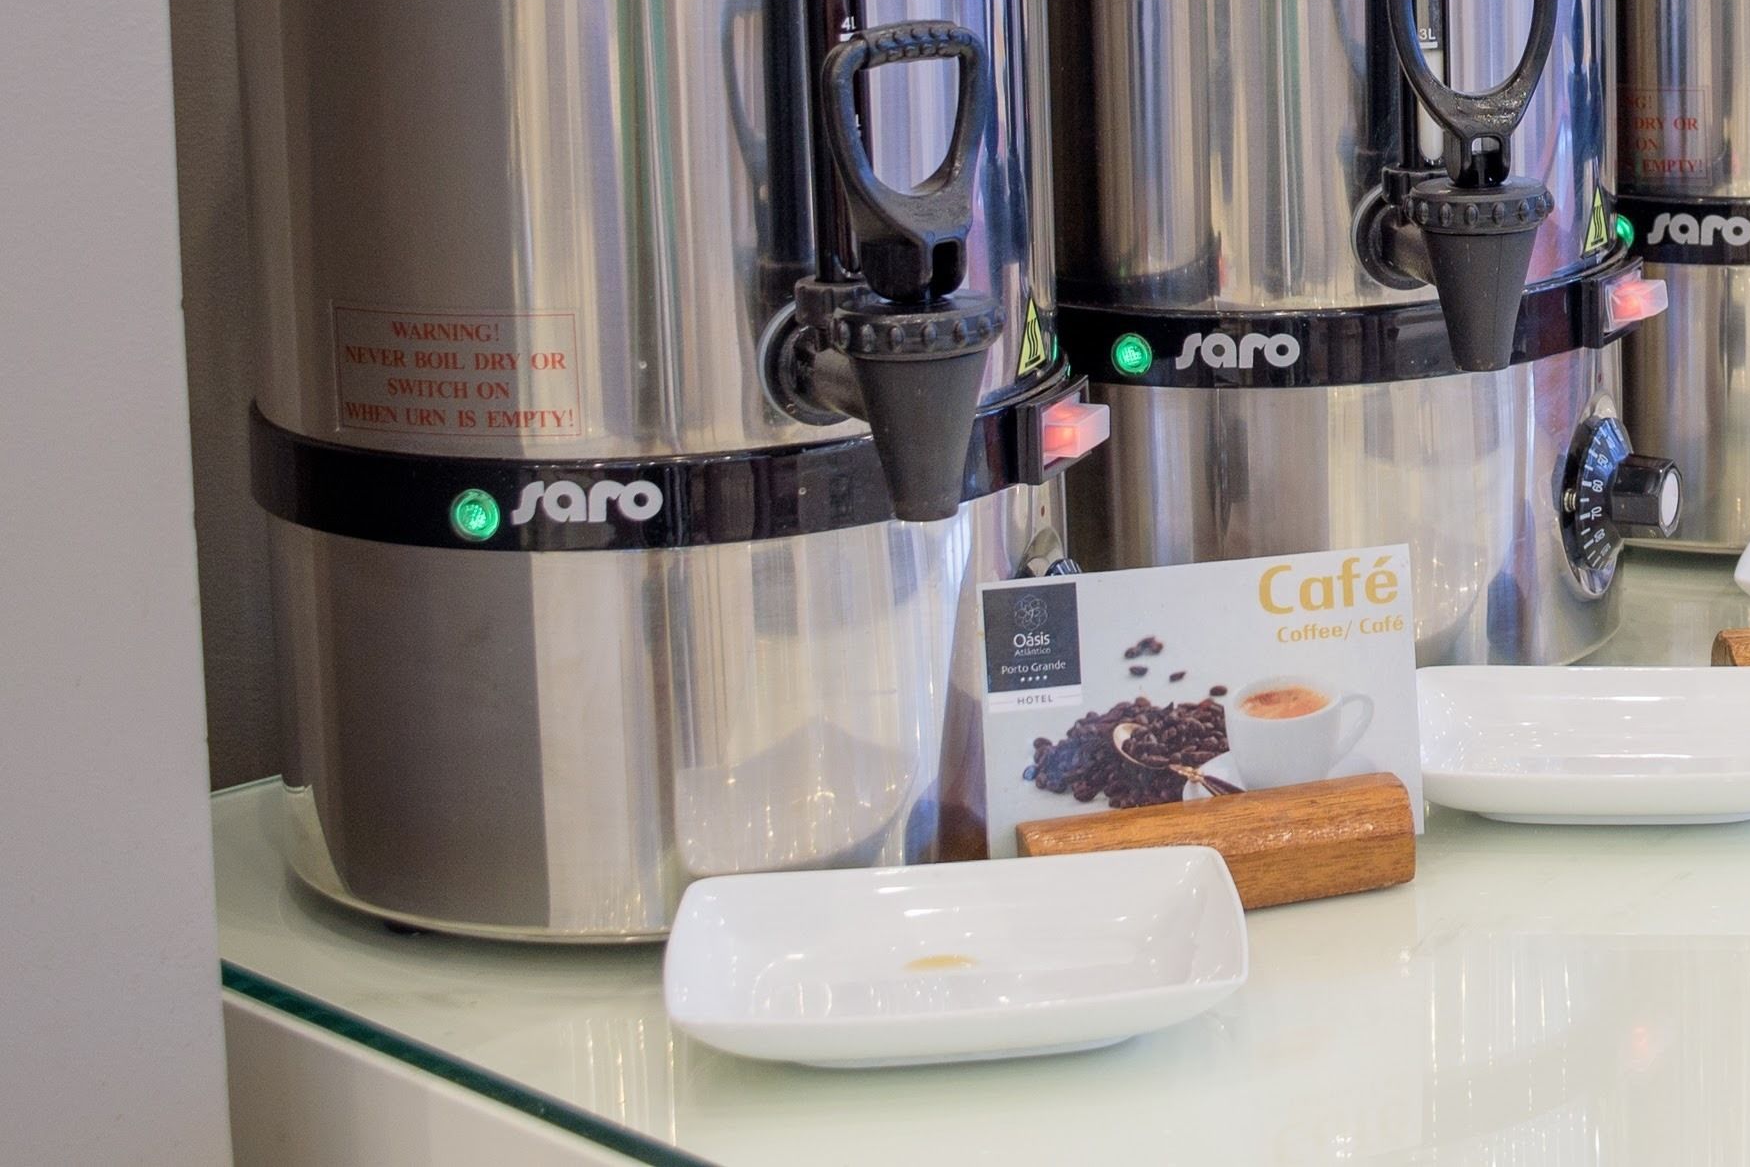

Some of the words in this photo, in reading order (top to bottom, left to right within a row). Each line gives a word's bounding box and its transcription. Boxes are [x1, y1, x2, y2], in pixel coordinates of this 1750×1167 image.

[1419, 28, 1436, 40] 3L
[1674, 117, 1698, 130] OR
[392, 321, 500, 343] WARNING!
[345, 346, 406, 368] NEVER
[415, 352, 464, 370] BOIL
[474, 353, 520, 370] DRY
[531, 352, 566, 370] OR
[1175, 333, 1300, 370] saro
[387, 377, 467, 399] SWITCH
[477, 381, 510, 399] ON
[344, 401, 398, 423] WHEN
[406, 409, 446, 426] URN
[458, 410, 476, 427] IS
[488, 409, 574, 428] EMPTY!
[1592, 479, 1603, 492] 60
[510, 479, 664, 524] saro
[1591, 506, 1602, 520] 70
[1259, 555, 1398, 615] Café
[1359, 615, 1404, 634] Café
[1013, 632, 1050, 648] Oásis
[1002, 664, 1029, 674] Porto
[1031, 660, 1066, 672] Grande
[1017, 694, 1053, 705] HOTEL
